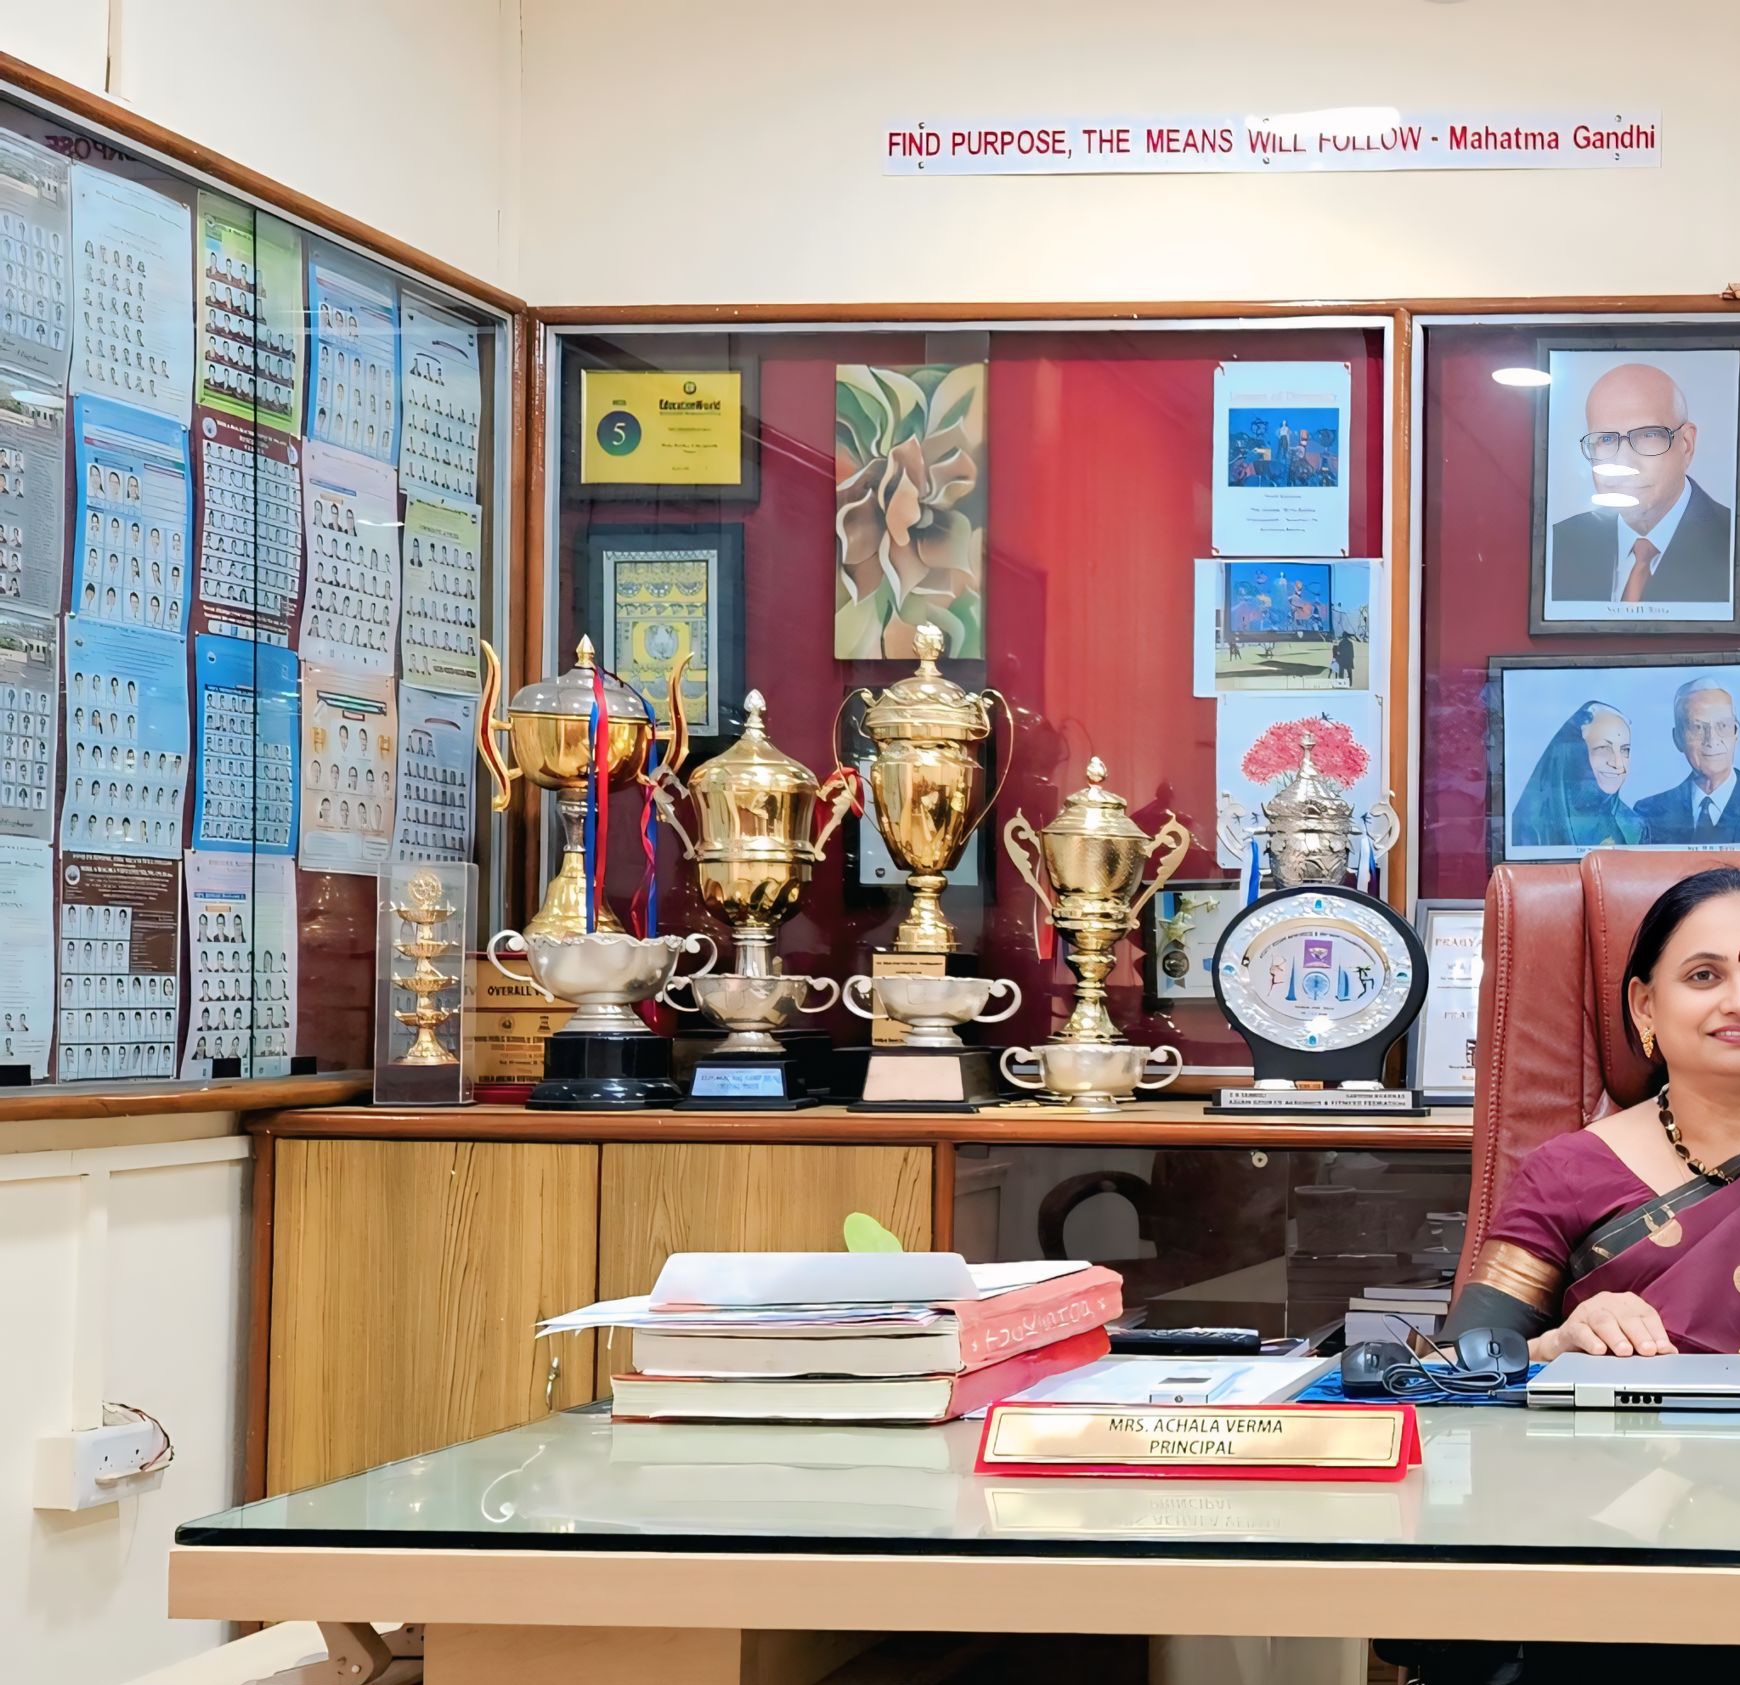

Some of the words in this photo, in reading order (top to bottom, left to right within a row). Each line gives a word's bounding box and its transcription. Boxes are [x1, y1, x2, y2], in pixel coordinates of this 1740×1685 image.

[888, 131, 941, 157] FIND
[951, 129, 1072, 159] PURPOSE,
[1082, 128, 1131, 154] THE
[1146, 128, 1233, 154] MEANS
[1449, 125, 1560, 151] Mahatma
[1573, 124, 1655, 150] Gandhi
[612, 422, 626, 446] 5
[487, 985, 532, 996] OVERALL
[1108, 1417, 1148, 1434] MRS.
[1153, 1417, 1220, 1434] ACHALA
[1226, 1417, 1284, 1434] VERMA
[1149, 1438, 1237, 1456] PRINCIPAL
